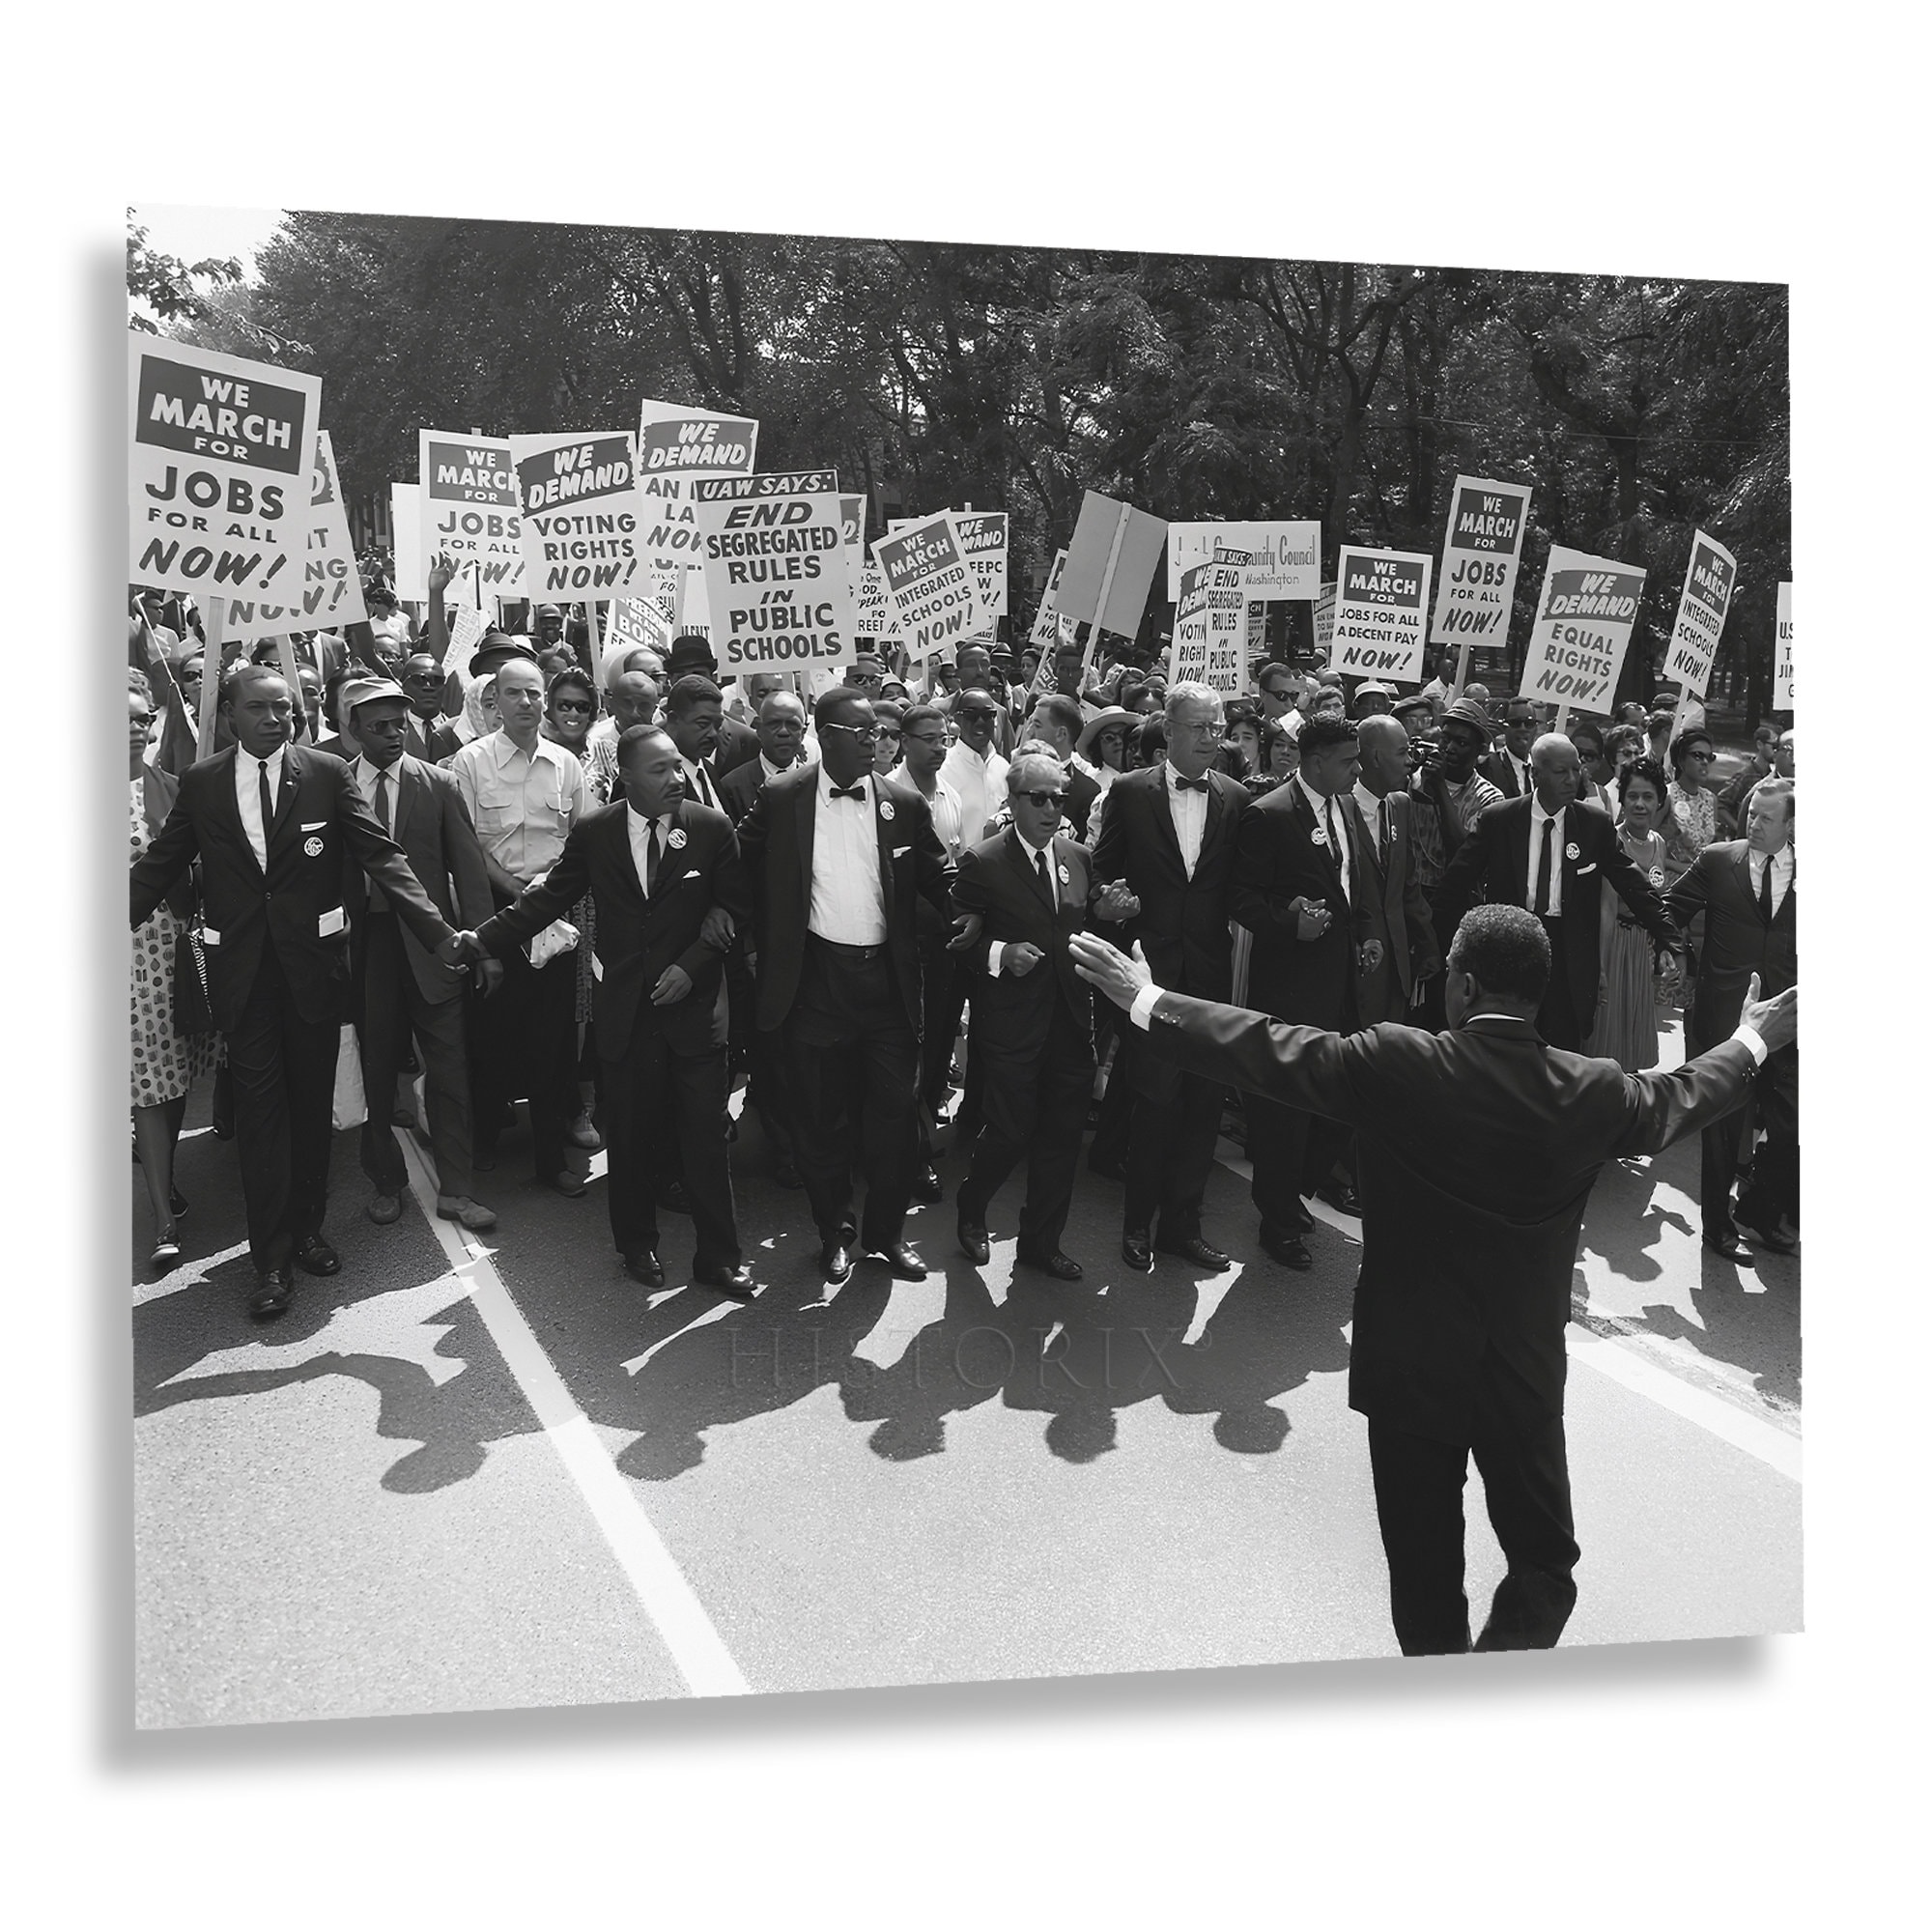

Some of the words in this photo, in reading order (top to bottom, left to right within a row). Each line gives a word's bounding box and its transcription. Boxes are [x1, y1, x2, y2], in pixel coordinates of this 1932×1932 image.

[200, 375, 250, 409] WE
[150, 392, 291, 450] MARCH
[677, 422, 720, 444] WE
[194, 437, 248, 460] FOR
[466, 449, 497, 468] WE
[554, 445, 594, 475] WE
[647, 443, 746, 469] DEMAND
[145, 466, 284, 520] JOBS
[464, 490, 498, 502] FOR
[528, 462, 629, 509] DEMAND
[645, 477, 680, 499] AN
[702, 478, 754, 499] UAW
[758, 473, 832, 495] SAYS:
[665, 503, 695, 524] LA
[724, 501, 813, 529] END
[1483, 496, 1503, 513] WE
[148, 507, 209, 532] FOR
[225, 523, 277, 543] ALL
[438, 511, 522, 539] JOBS
[532, 513, 637, 536] VOTING
[959, 520, 984, 537] WE
[1459, 512, 1516, 538] MARCH
[440, 538, 477, 551] FOR
[488, 543, 521, 554] ALL
[544, 539, 635, 561] RIGHTS
[706, 526, 838, 559] SEGREGATED
[901, 533, 926, 553] WE
[962, 530, 1003, 551] MAND
[1279, 534, 1316, 565] Council
[1474, 537, 1495, 549] FOR
[139, 537, 287, 589] NOW!
[727, 554, 821, 584] RULES
[890, 537, 951, 579] MARCH
[969, 560, 1003, 574] FEPC
[1374, 561, 1397, 576] WE
[1711, 555, 1724, 576] WE
[547, 558, 638, 591] NOW!
[911, 562, 937, 580] FOR
[1214, 569, 1239, 587] END
[1245, 573, 1299, 590] Washington
[1451, 559, 1507, 587] JOBS
[895, 567, 965, 609] INTEGRATED
[1350, 574, 1417, 596] MARCH
[1579, 573, 1617, 594] WE
[1693, 565, 1727, 602] MARCH
[760, 589, 794, 605] IN
[902, 585, 972, 627] SCHOOLS
[1369, 593, 1395, 603] FOR
[1450, 588, 1476, 602] FOR
[1480, 591, 1500, 603] ALL
[1550, 594, 1635, 617] DEMAND
[1702, 590, 1716, 604] FOR
[729, 603, 835, 633] PUBLIC
[917, 603, 974, 649] NOW!
[1212, 612, 1236, 631] RULES
[1340, 608, 1370, 621] JOBS
[1373, 611, 1397, 623] FOR
[1399, 613, 1420, 626] ALL
[1442, 608, 1503, 634] NOW!
[1683, 599, 1719, 637] INTEGRATED
[1219, 639, 1229, 648] IN
[1337, 626, 1347, 636] A
[1349, 627, 1393, 642] DECENT
[1394, 632, 1418, 644] PAY
[1550, 623, 1613, 655] EQUAL
[1678, 622, 1714, 658] SCHOOLS
[727, 632, 842, 664] SCHOOLS
[1179, 645, 1206, 662] RIGHT
[1209, 650, 1237, 669] PUBLIC
[1343, 647, 1412, 670] NOW!
[1545, 644, 1611, 677] RIGHTS
[1673, 648, 1708, 683] NOW!
[1536, 668, 1608, 702] NOW!
